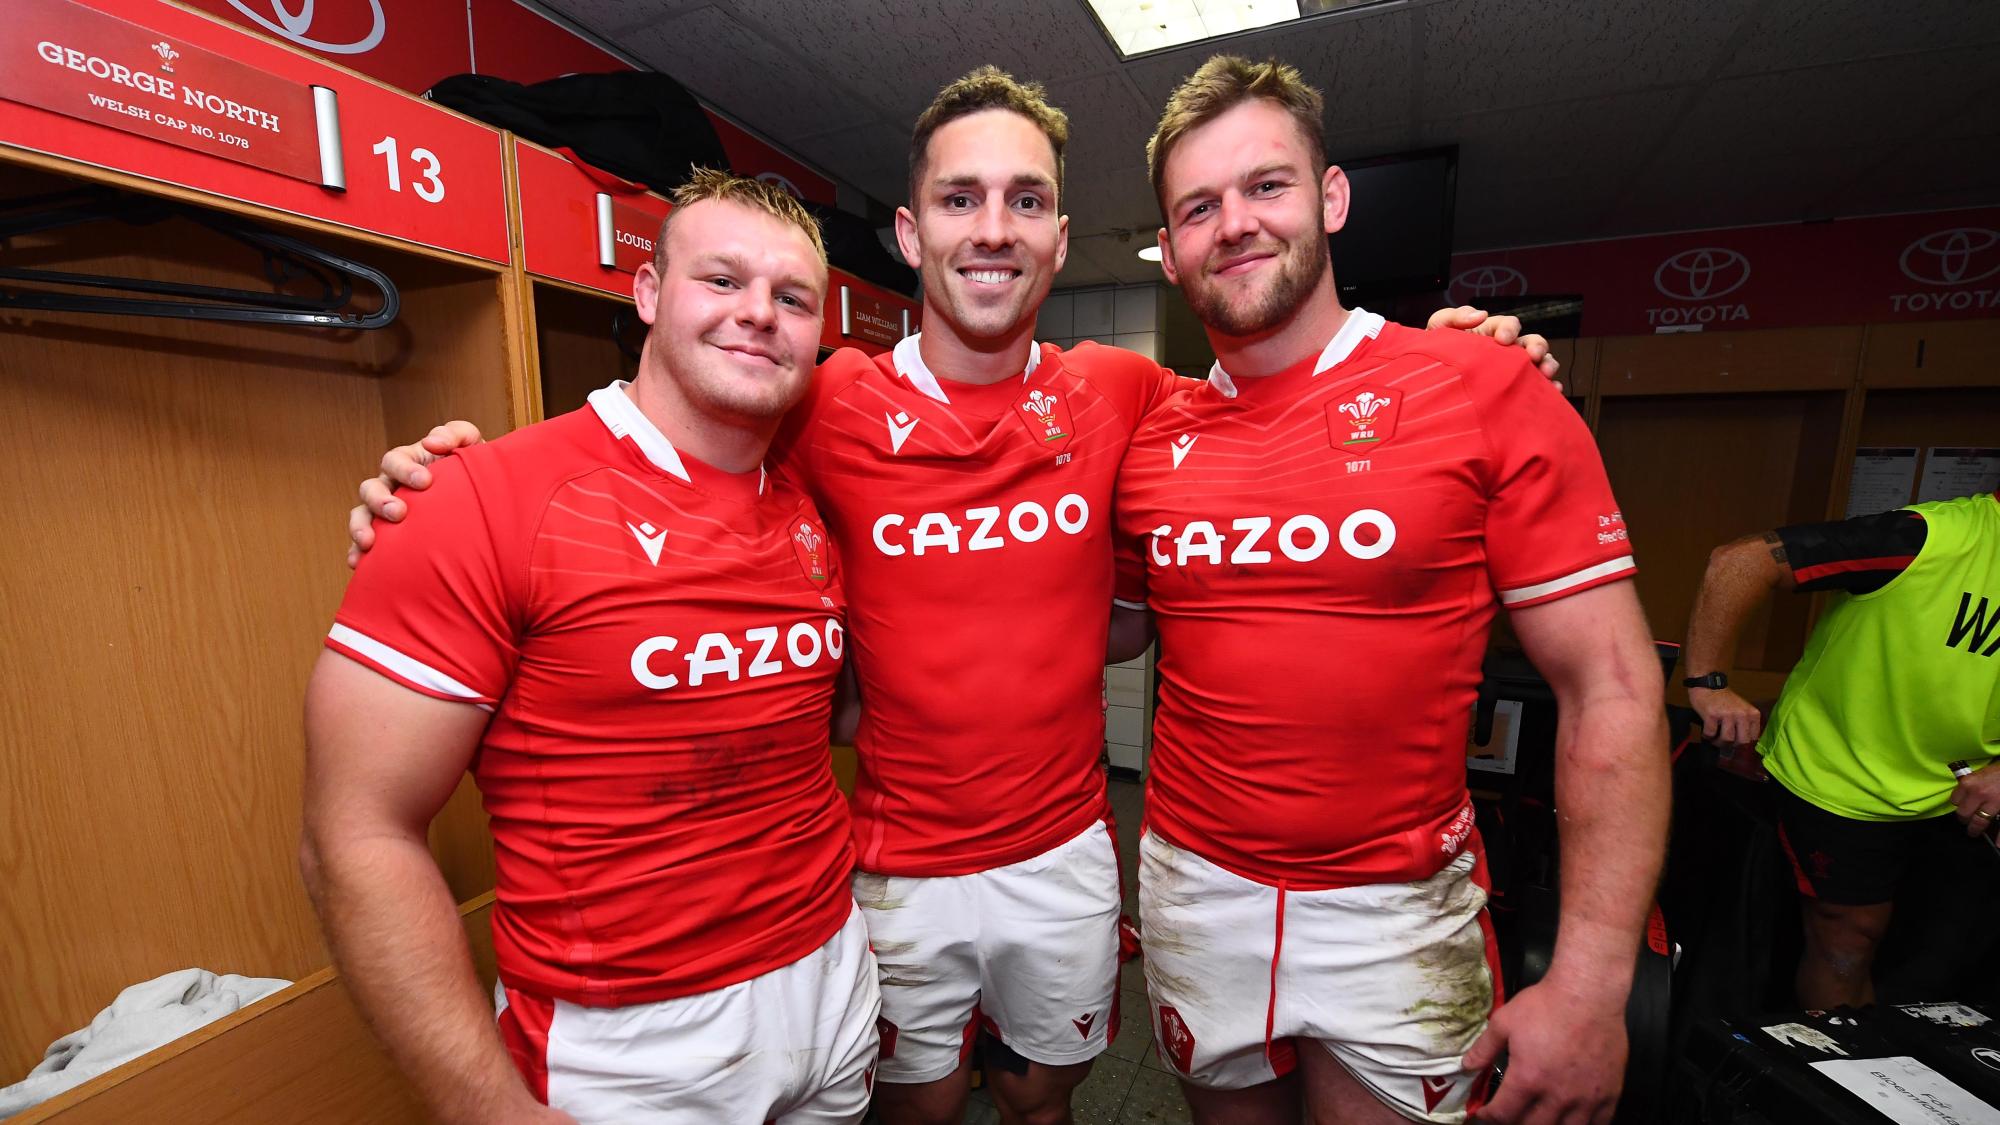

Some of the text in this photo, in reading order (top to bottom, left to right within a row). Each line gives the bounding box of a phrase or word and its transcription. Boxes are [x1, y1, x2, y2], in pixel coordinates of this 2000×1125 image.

[37, 41, 281, 133] GEORGE NORTH
[88, 93, 250, 149] WELSH CAP NO. 1078
[373, 136, 445, 203] 13
[616, 229, 652, 251] LOUIS
[856, 311, 871, 325] LIAM
[872, 315, 898, 331] WILLIAMS
[1645, 303, 1751, 325] TOYOTA
[1045, 426, 1061, 437] WRU
[1351, 429, 1374, 440] WRU
[872, 493, 1089, 556] CAZOO
[1151, 509, 1396, 567] CAZOO
[1945, 591, 2000, 657] W
[630, 618, 843, 690] CAZOO
[1920, 1093, 1953, 1110] For
